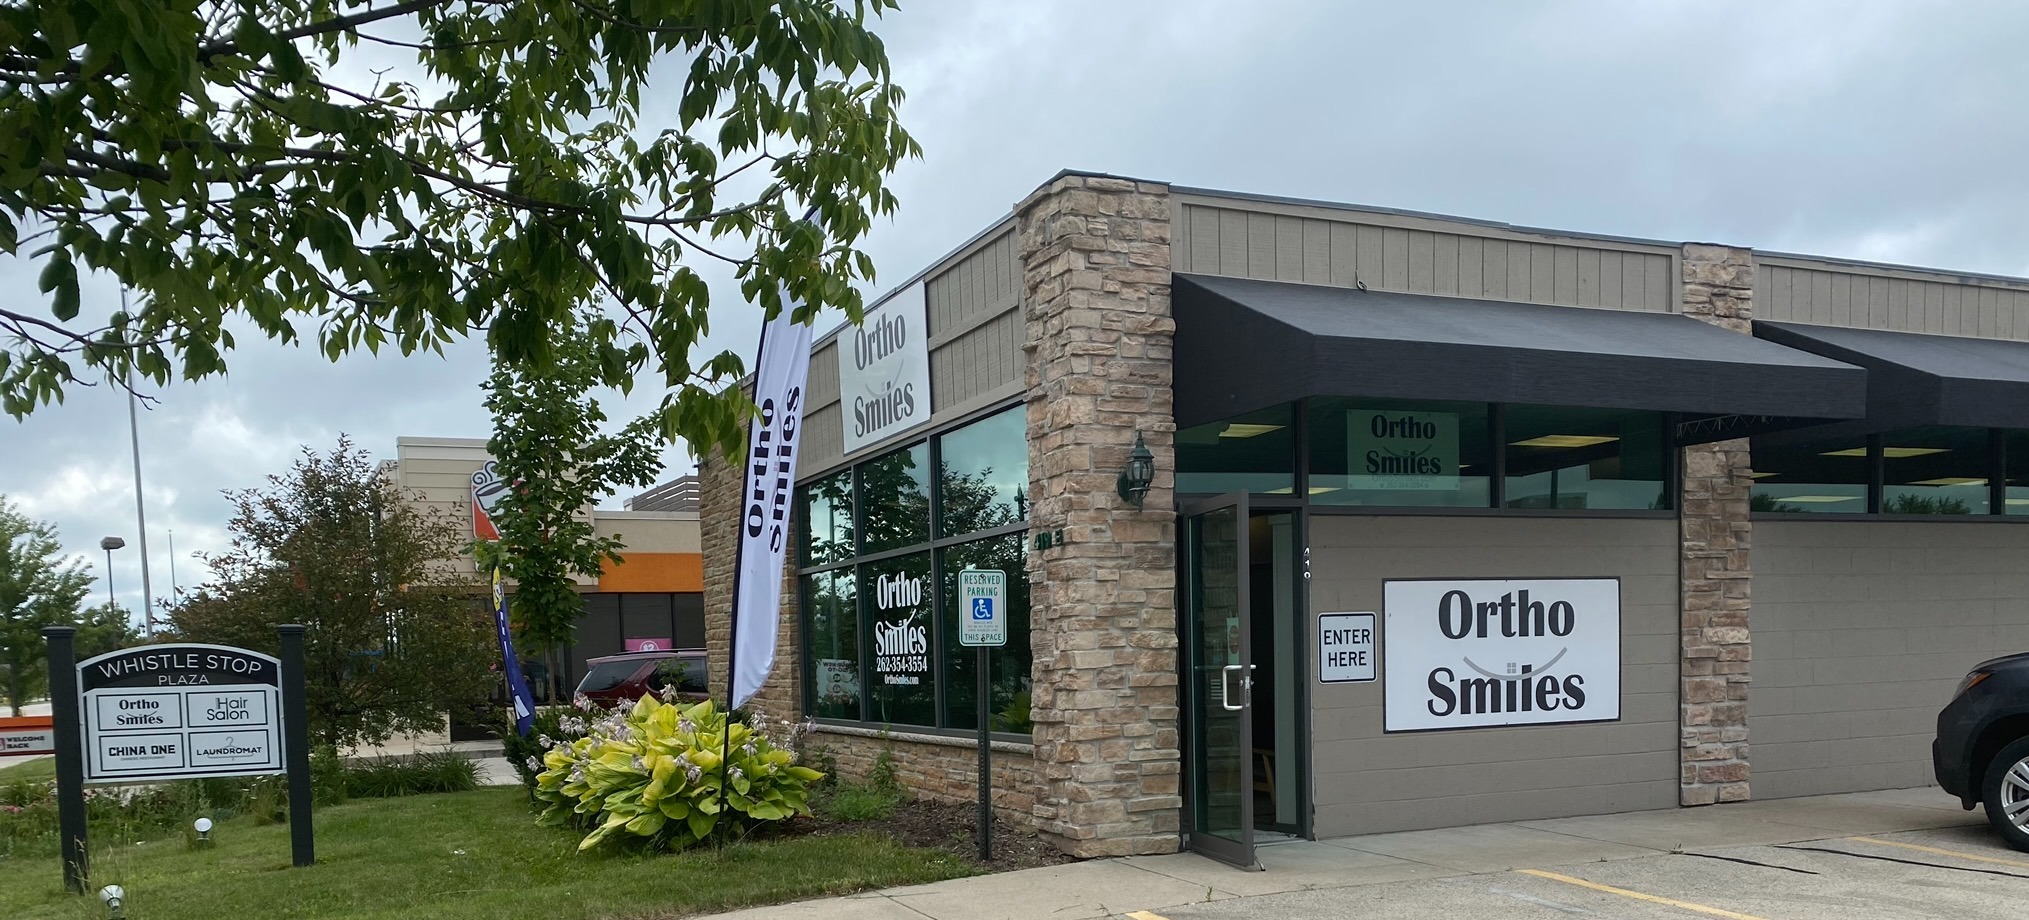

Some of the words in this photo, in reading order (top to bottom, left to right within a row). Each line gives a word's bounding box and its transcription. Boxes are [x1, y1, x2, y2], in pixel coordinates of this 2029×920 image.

[854, 313, 906, 371] Ortho
[854, 382, 914, 438] Smiles
[1371, 415, 1436, 439] Ortho
[749, 398, 774, 538] Ortho
[770, 386, 800, 553] Smiles
[1366, 450, 1441, 474] Smiles
[965, 575, 1001, 584] RESERVED
[876, 571, 921, 610] Ortho
[967, 587, 998, 596] PARKING
[1438, 589, 1575, 640] Ortho
[875, 619, 927, 656] Smiles
[1324, 629, 1371, 646] ENTER
[98, 654, 199, 678] WHISTLE
[206, 654, 262, 675] STOP
[876, 656, 928, 672] 262-354-3554
[1327, 651, 1367, 667] HERE
[158, 675, 210, 686] PLAZA
[1427, 665, 1586, 717] Smiles
[118, 699, 160, 710] Ortho
[216, 697, 248, 710] Hair
[116, 714, 164, 725] Smiles
[206, 708, 249, 721] Salon
[108, 746, 147, 757] CHINA
[151, 745, 176, 755] ONE
[196, 747, 262, 756] LAUNDROMAT
